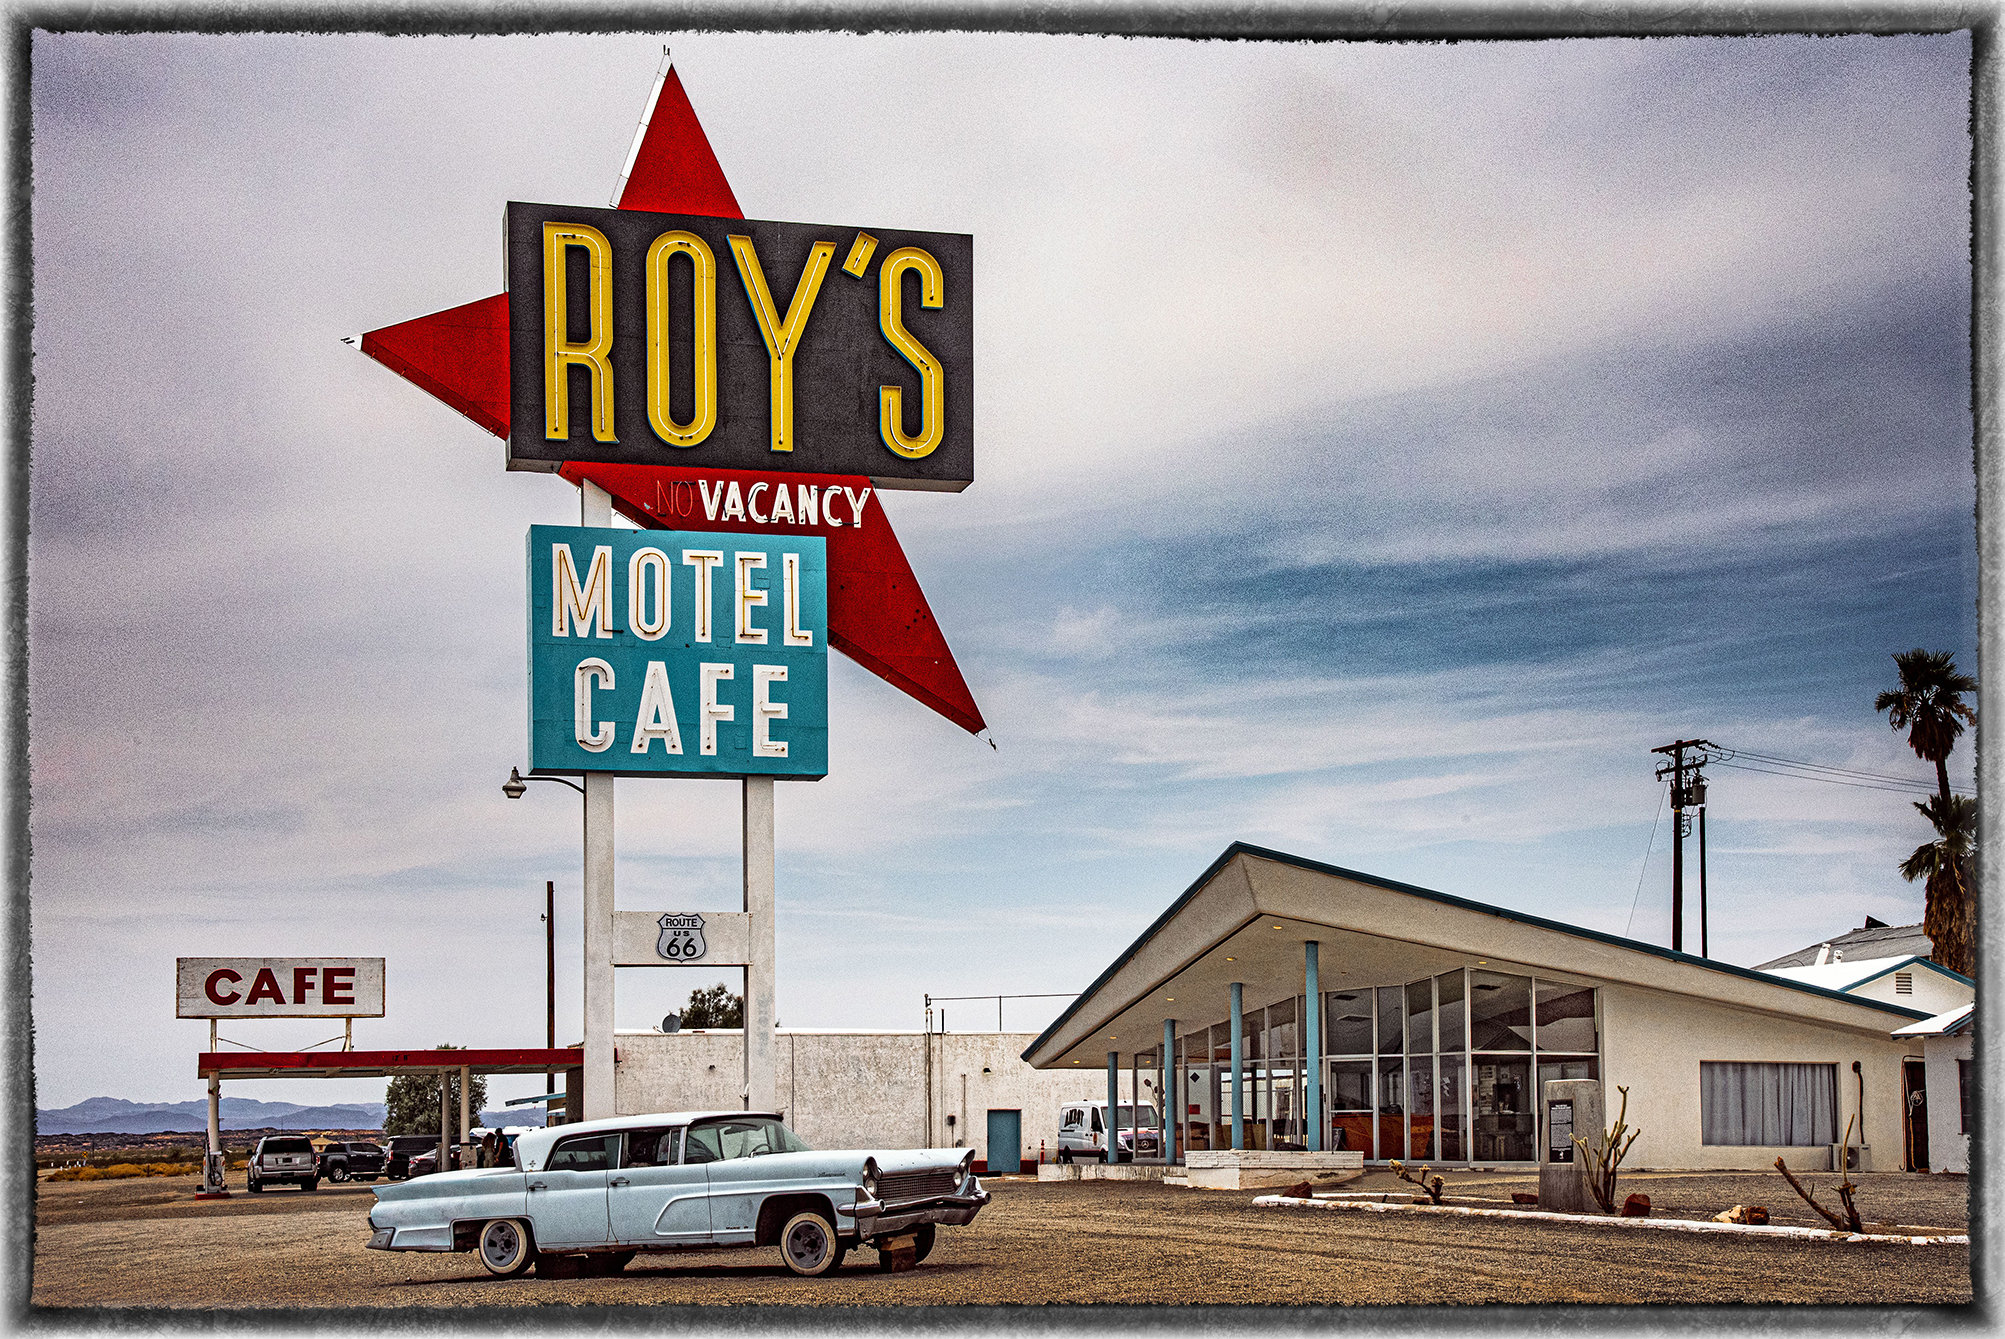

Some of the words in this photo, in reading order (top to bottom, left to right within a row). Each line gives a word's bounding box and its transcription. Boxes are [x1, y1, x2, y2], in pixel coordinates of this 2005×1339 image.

[543, 221, 944, 460] ROY'S
[657, 480, 693, 517] NO
[698, 480, 871, 528] VACANCY
[552, 543, 813, 646] MOTEL
[574, 657, 789, 757] CAFE
[667, 938, 697, 957] 66
[204, 967, 356, 1006] CAFE
